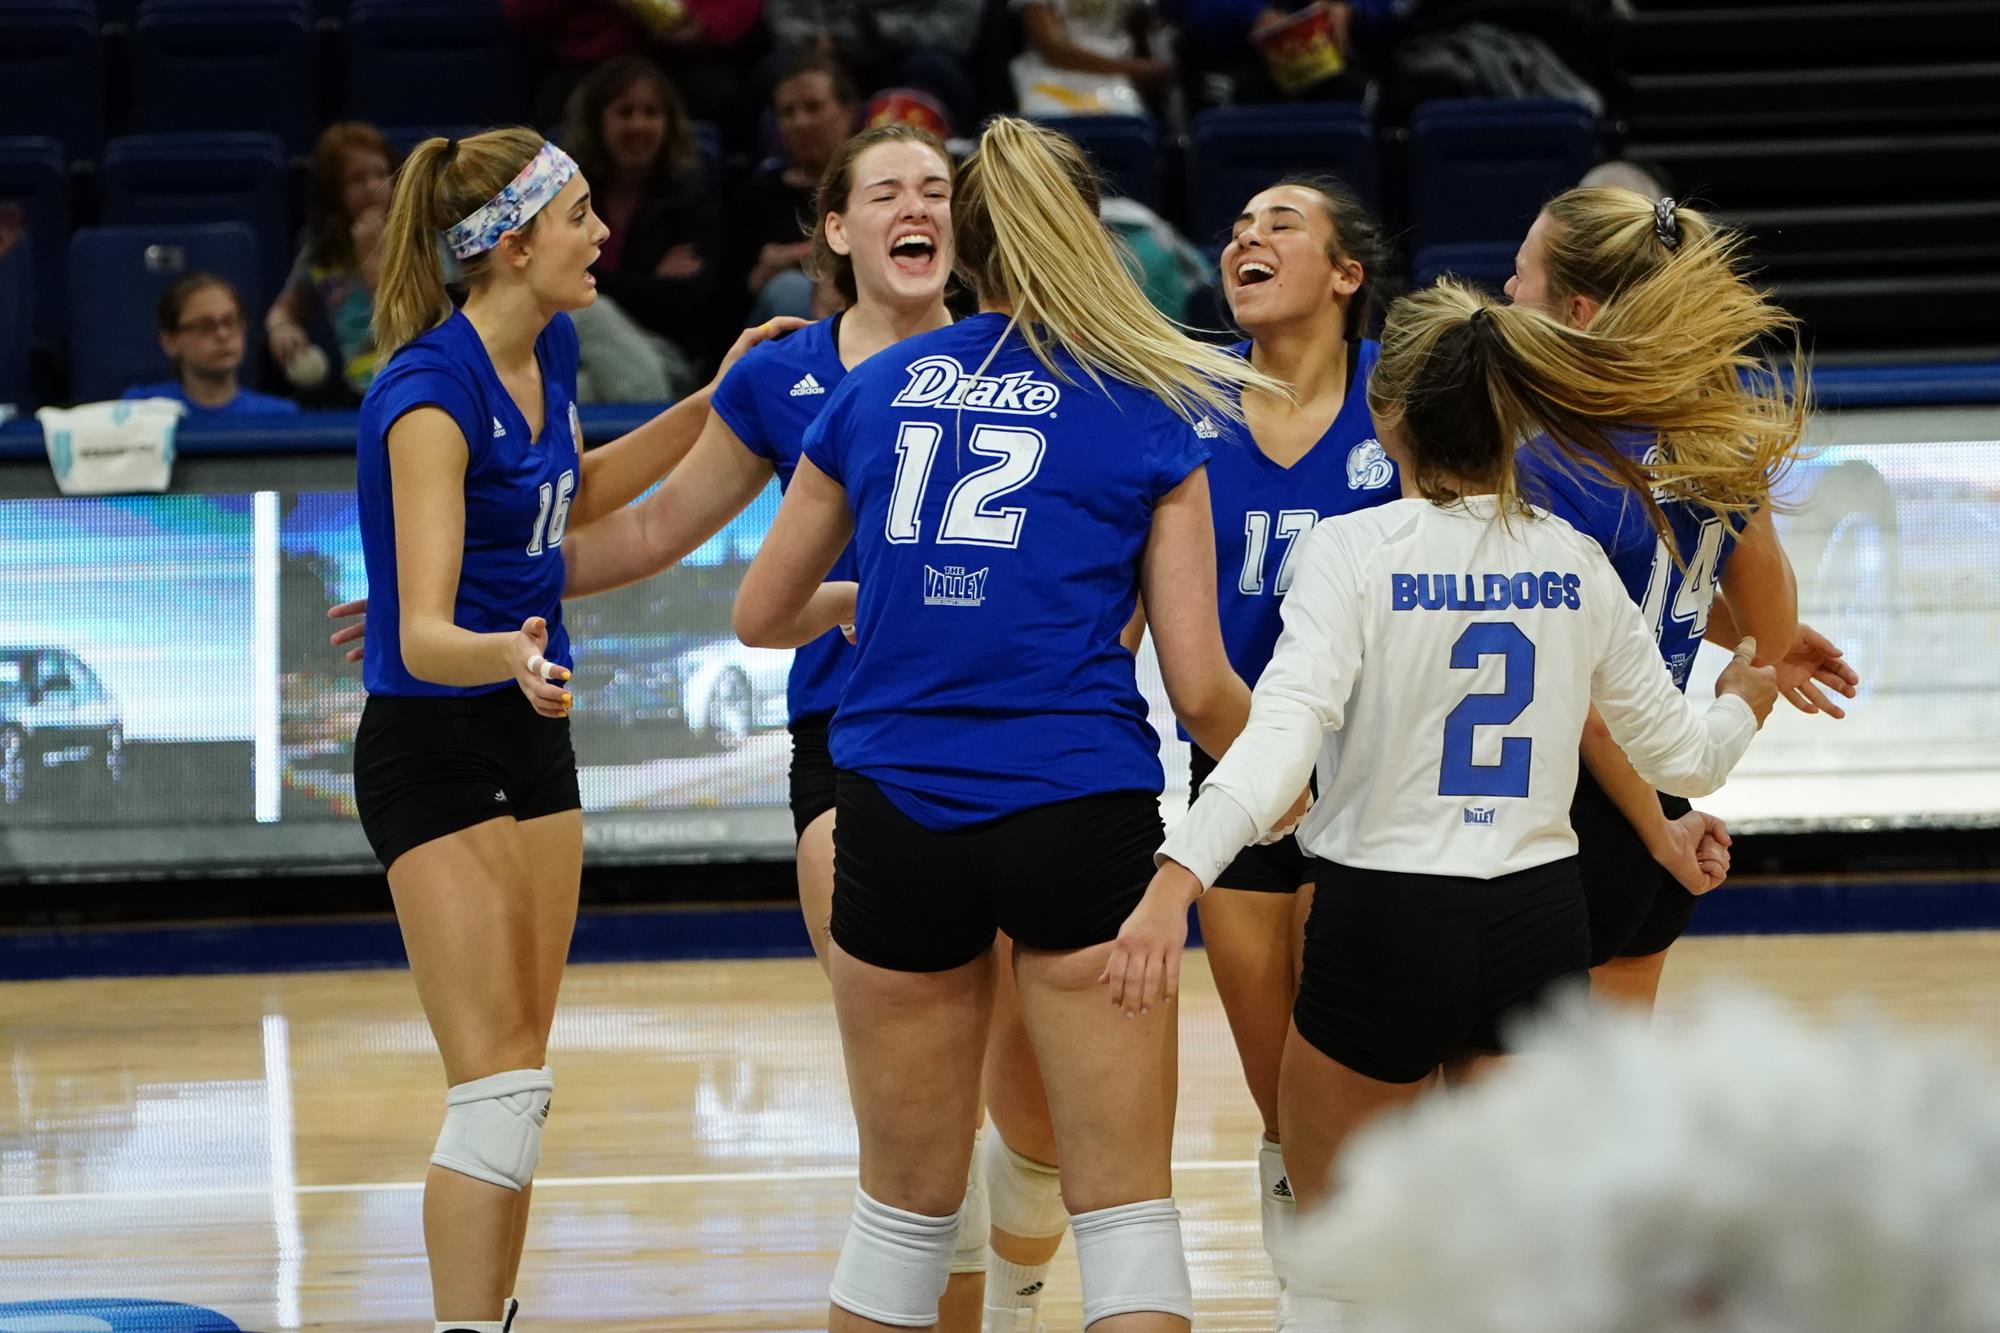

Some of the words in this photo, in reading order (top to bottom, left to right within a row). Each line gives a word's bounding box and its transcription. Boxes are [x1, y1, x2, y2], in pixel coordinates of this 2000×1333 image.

[790, 387, 825, 397] adidas
[891, 355, 1060, 416] Drake
[885, 421, 1047, 549] 12
[526, 469, 575, 557] 16
[944, 566, 965, 576] THE
[1239, 508, 1319, 596] 17
[924, 564, 989, 601] VALLEY
[1391, 571, 1581, 611] BULLDOGS
[1640, 517, 1725, 647] 14
[1438, 621, 1536, 798] 2
[584, 820, 728, 846] KTRONICS
[1464, 807, 1496, 824] VALLEY
